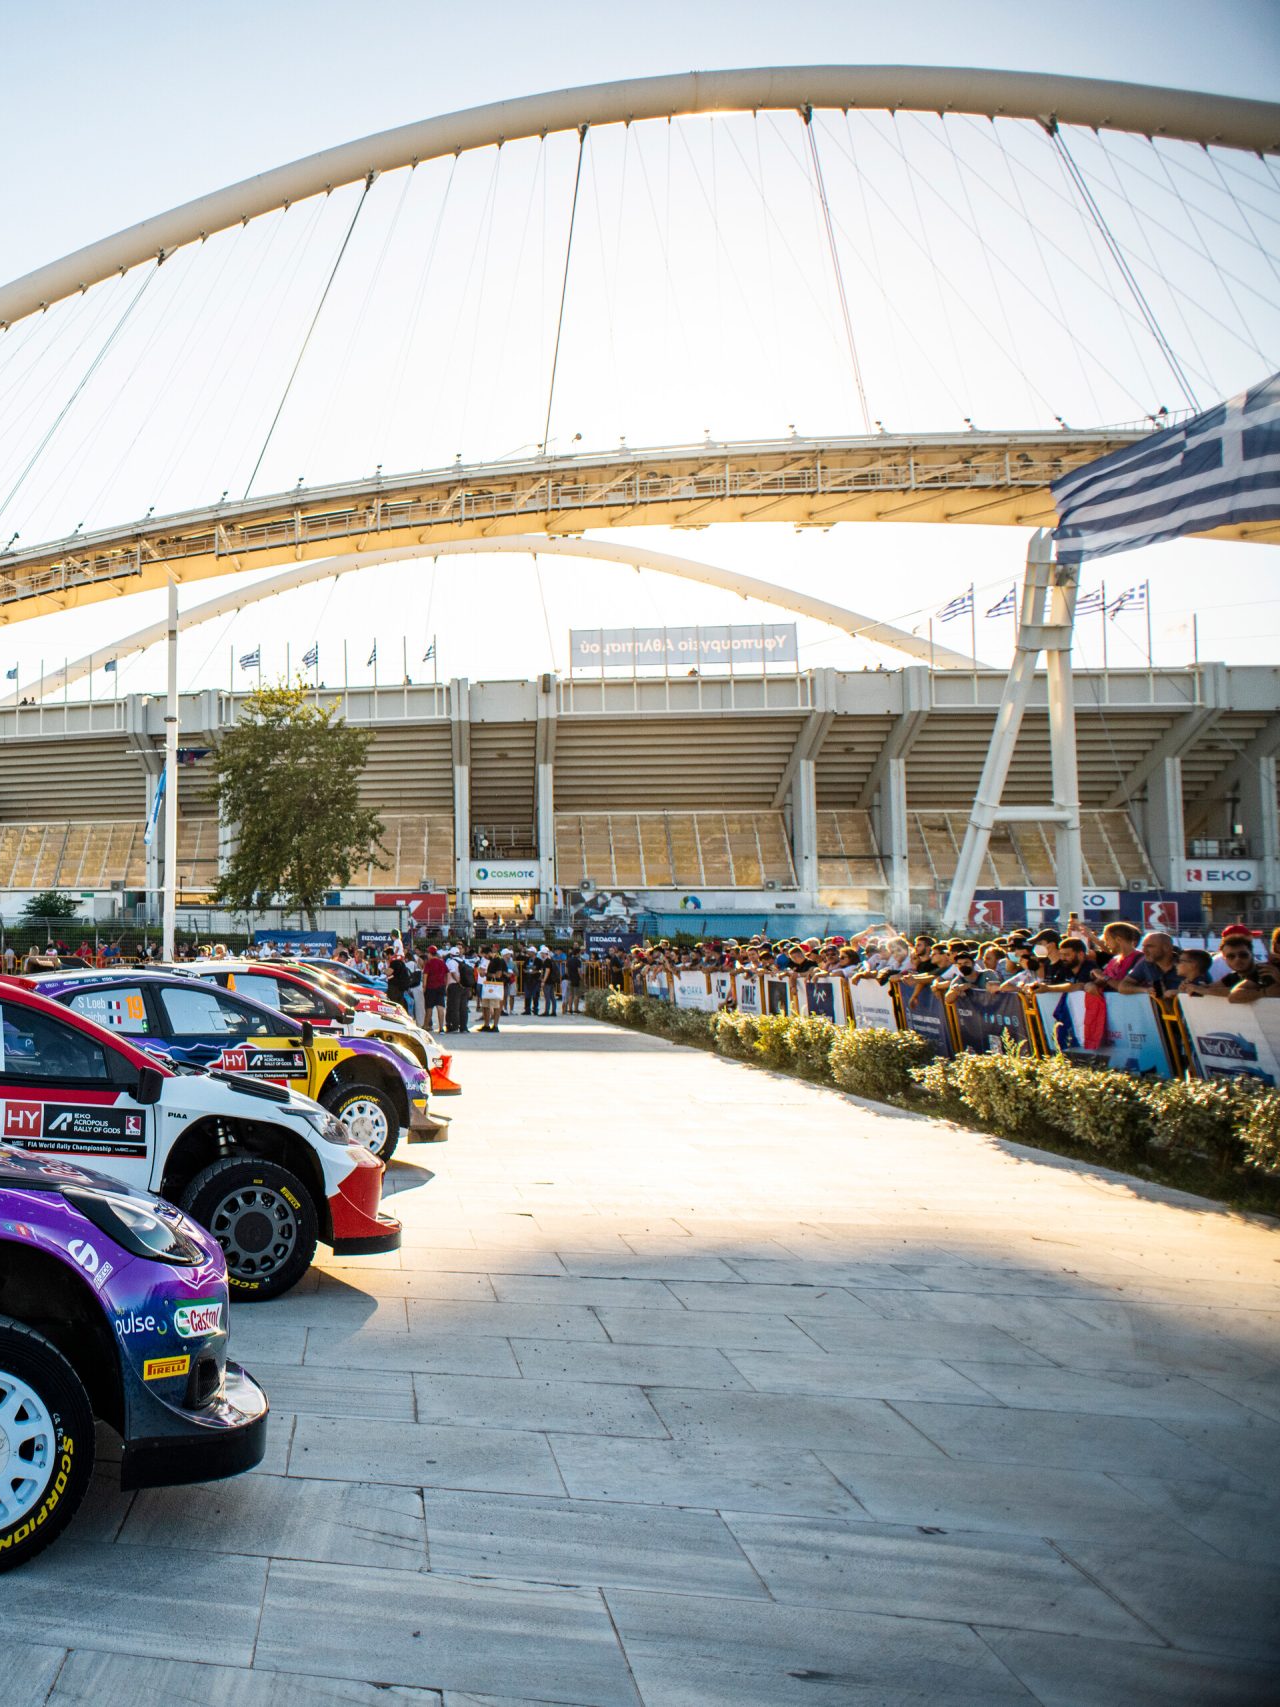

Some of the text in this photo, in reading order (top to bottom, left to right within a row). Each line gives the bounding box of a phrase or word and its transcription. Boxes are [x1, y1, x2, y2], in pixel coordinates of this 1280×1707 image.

[490, 870, 535, 878] COSMOTE
[1206, 870, 1252, 881] EKO
[78, 996, 106, 1009] S Loeb
[125, 995, 144, 1020] 19
[82, 1012, 106, 1024] miche
[225, 1054, 244, 1067] HY
[317, 1050, 338, 1062] Wilf
[7, 1109, 40, 1129] HY
[167, 1111, 188, 1119] PIAA
[73, 1119, 108, 1127] ACROPOLIS
[72, 1143, 112, 1152] Championship
[115, 1311, 155, 1335] pulse
[189, 1307, 220, 1333] Castrol
[148, 1359, 187, 1376] PIRELLI
